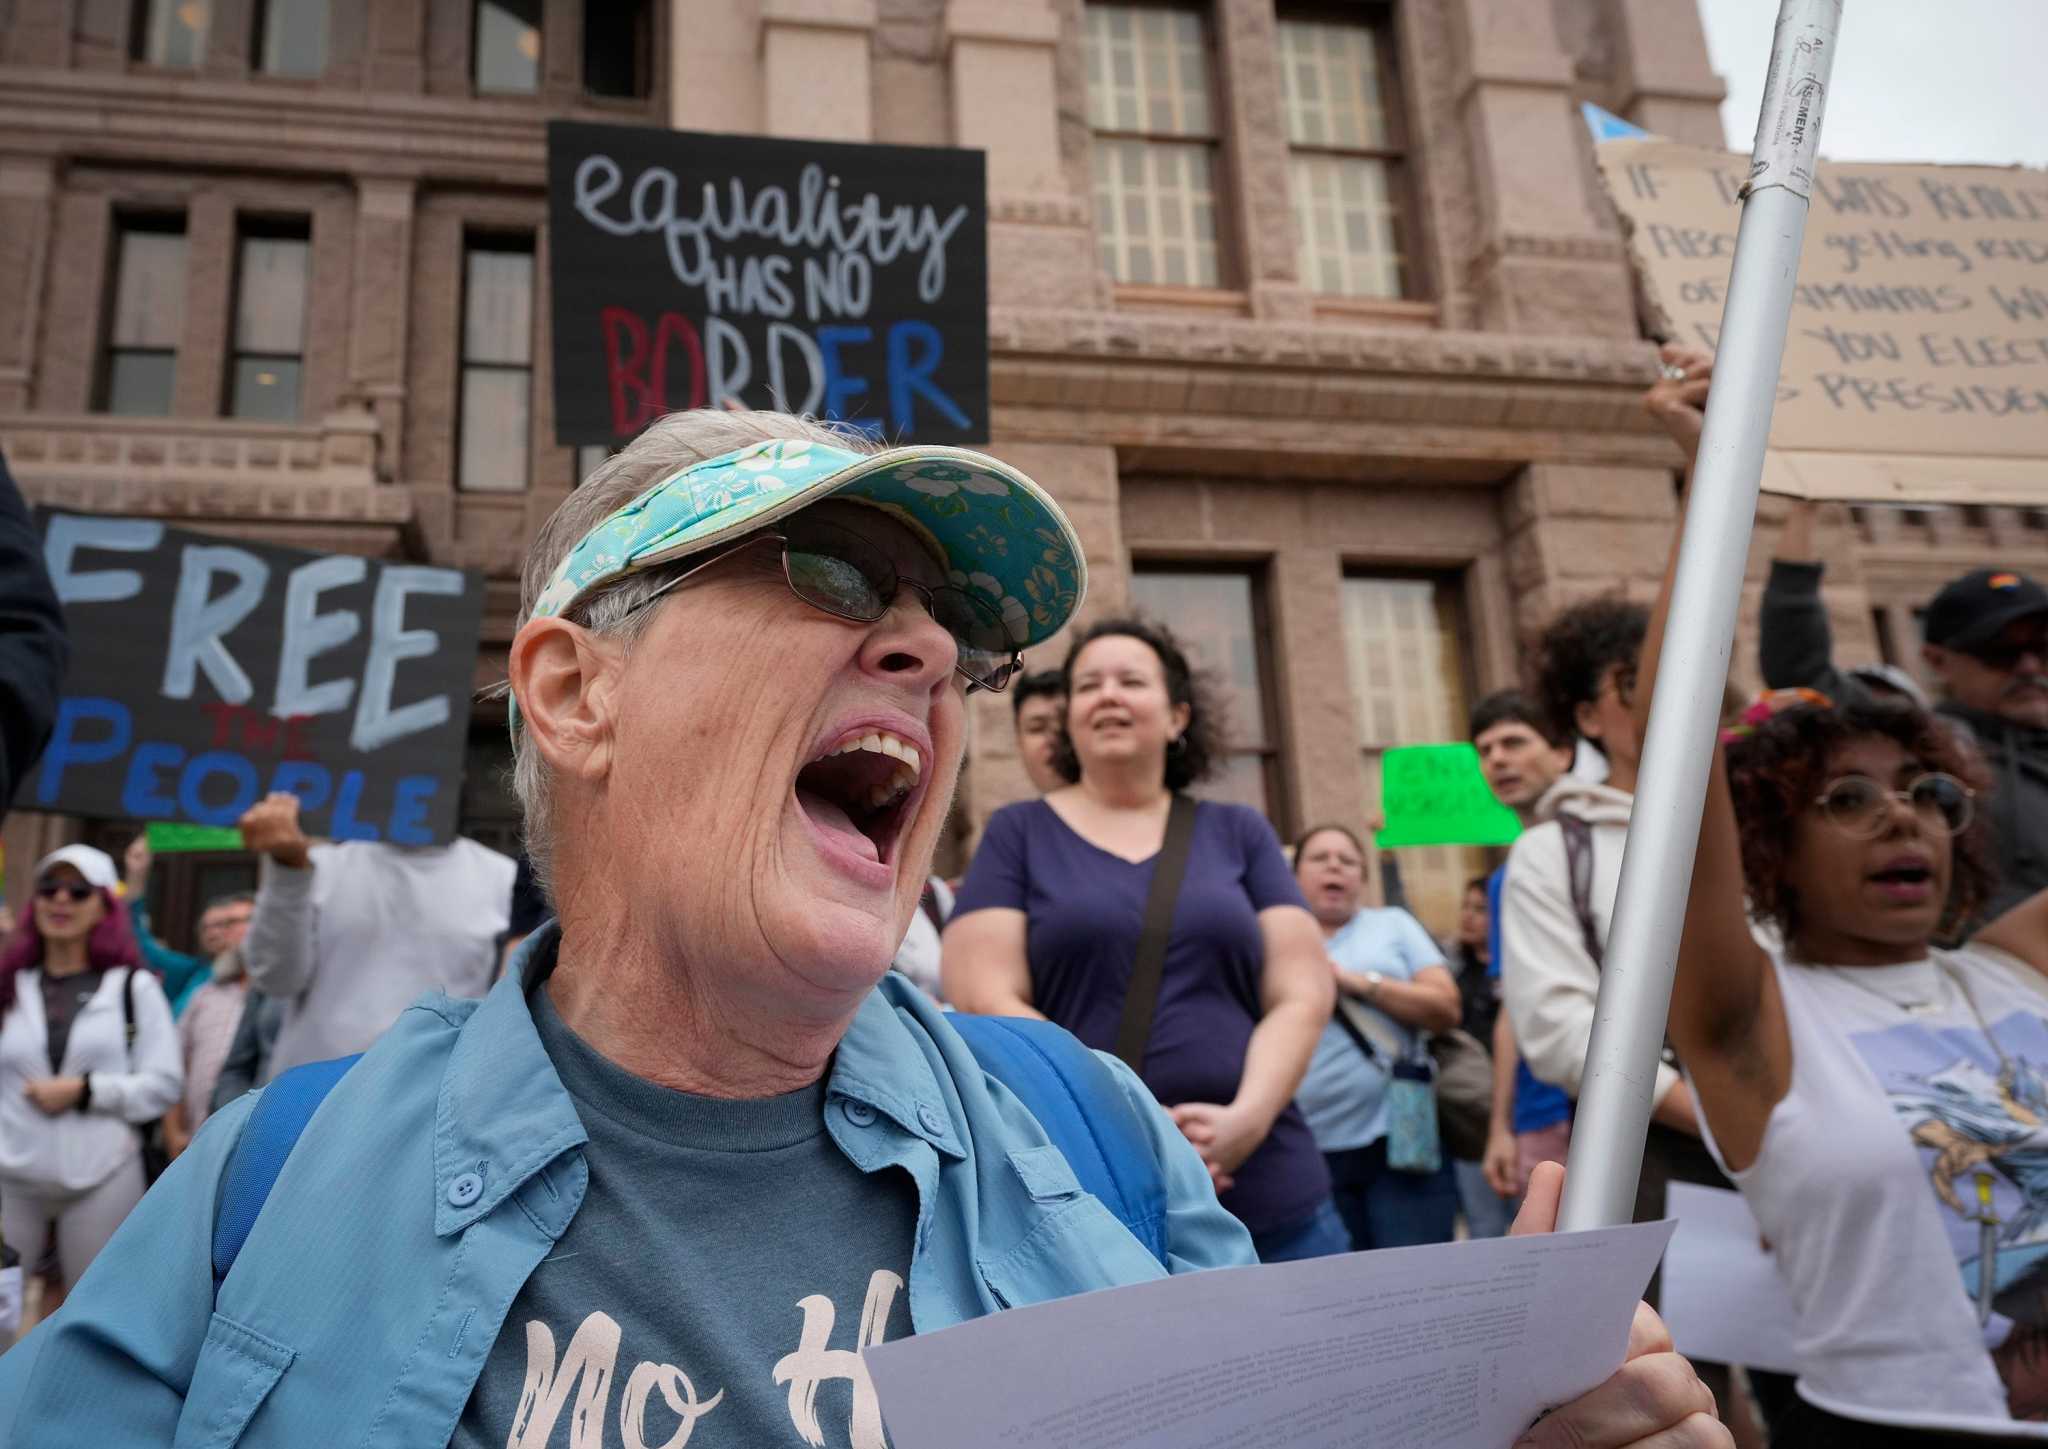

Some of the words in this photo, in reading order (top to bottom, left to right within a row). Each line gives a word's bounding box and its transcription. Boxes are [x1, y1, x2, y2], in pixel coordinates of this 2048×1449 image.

[574, 155, 968, 303] equality
[1919, 177, 2048, 221] REALL
[708, 254, 795, 318] HAS
[804, 252, 871, 320] NO
[603, 307, 972, 440] BORDER
[1801, 325, 1901, 364] YOU
[44, 514, 465, 752] FREE
[36, 698, 439, 843] PEOPLE
[202, 703, 316, 759] THE
